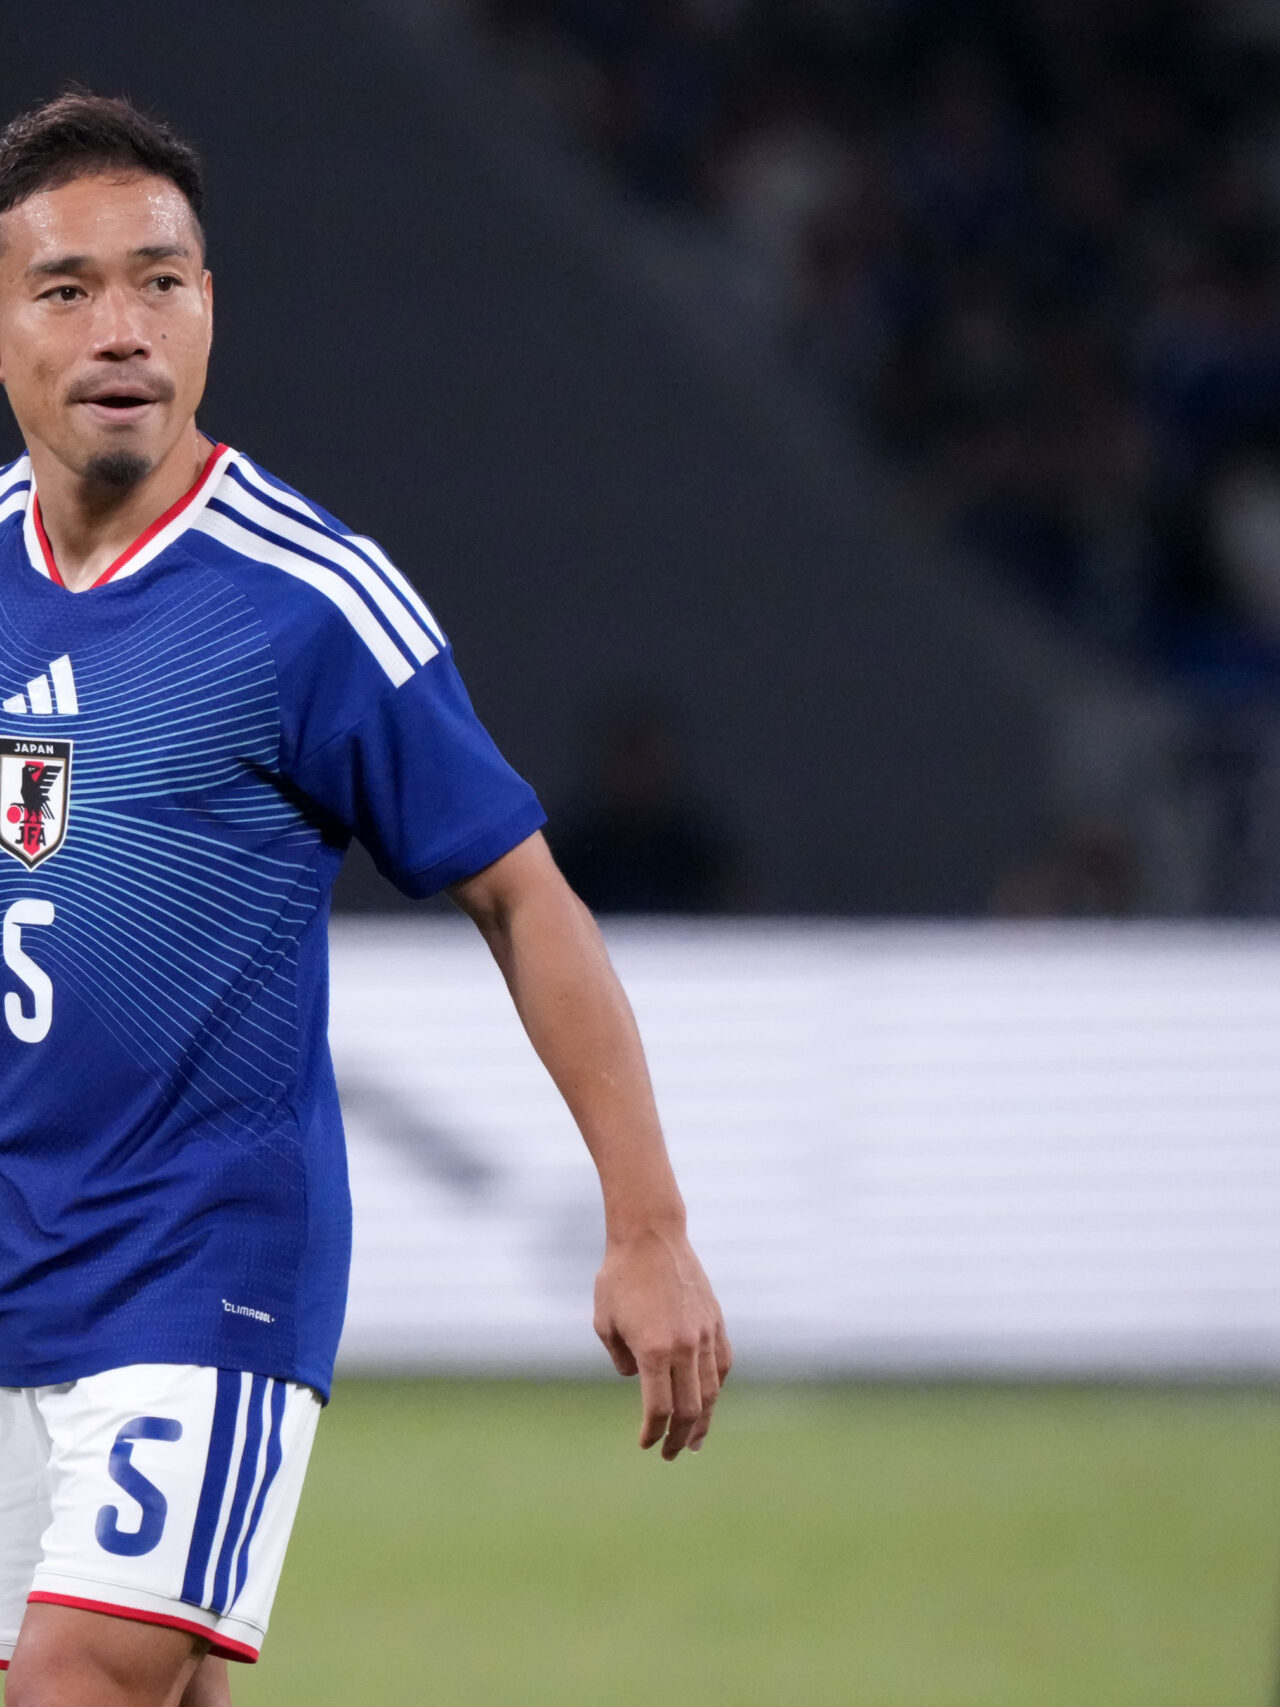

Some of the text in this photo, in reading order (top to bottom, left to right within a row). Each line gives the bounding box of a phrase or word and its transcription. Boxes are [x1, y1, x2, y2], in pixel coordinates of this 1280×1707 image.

[14, 743, 54, 754] JAPAN
[15, 826, 46, 846] JFA
[3, 899, 55, 1043] 5
[95, 1416, 183, 1557] 5
